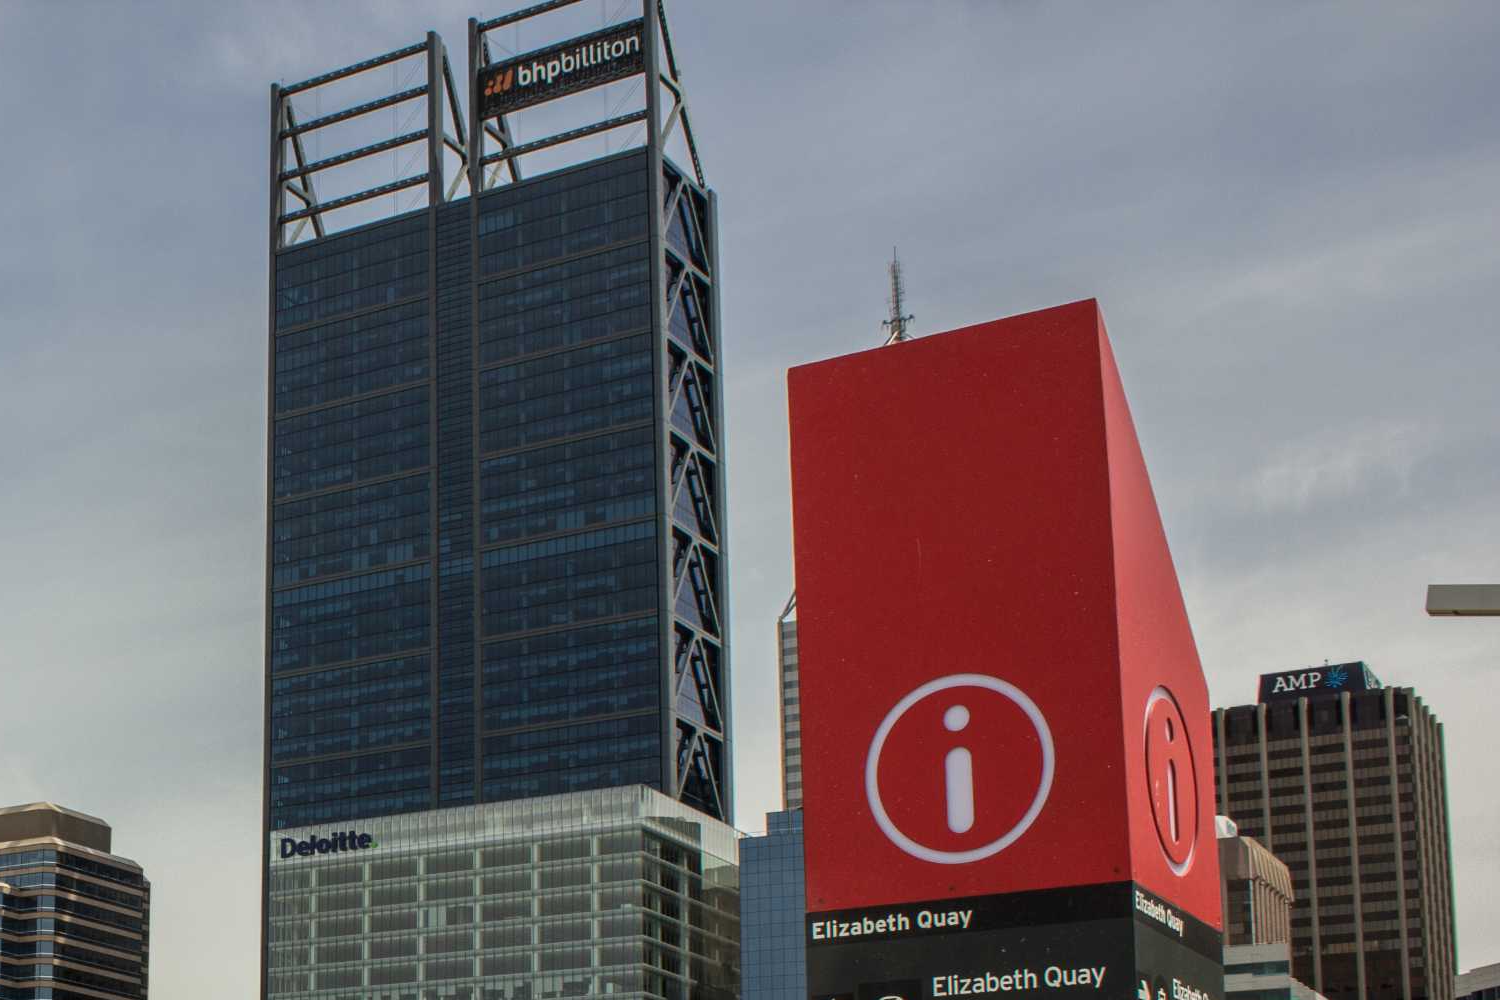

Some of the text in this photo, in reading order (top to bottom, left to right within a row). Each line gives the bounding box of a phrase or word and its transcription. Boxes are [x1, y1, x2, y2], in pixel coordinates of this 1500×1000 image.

[517, 34, 640, 86] bhpbilliton
[1271, 671, 1322, 694] AMP
[812, 909, 973, 940] Elizabeth Quay
[1135, 890, 1185, 937] Elizabeth Quay
[932, 965, 1106, 997] Elizabeth Quay
